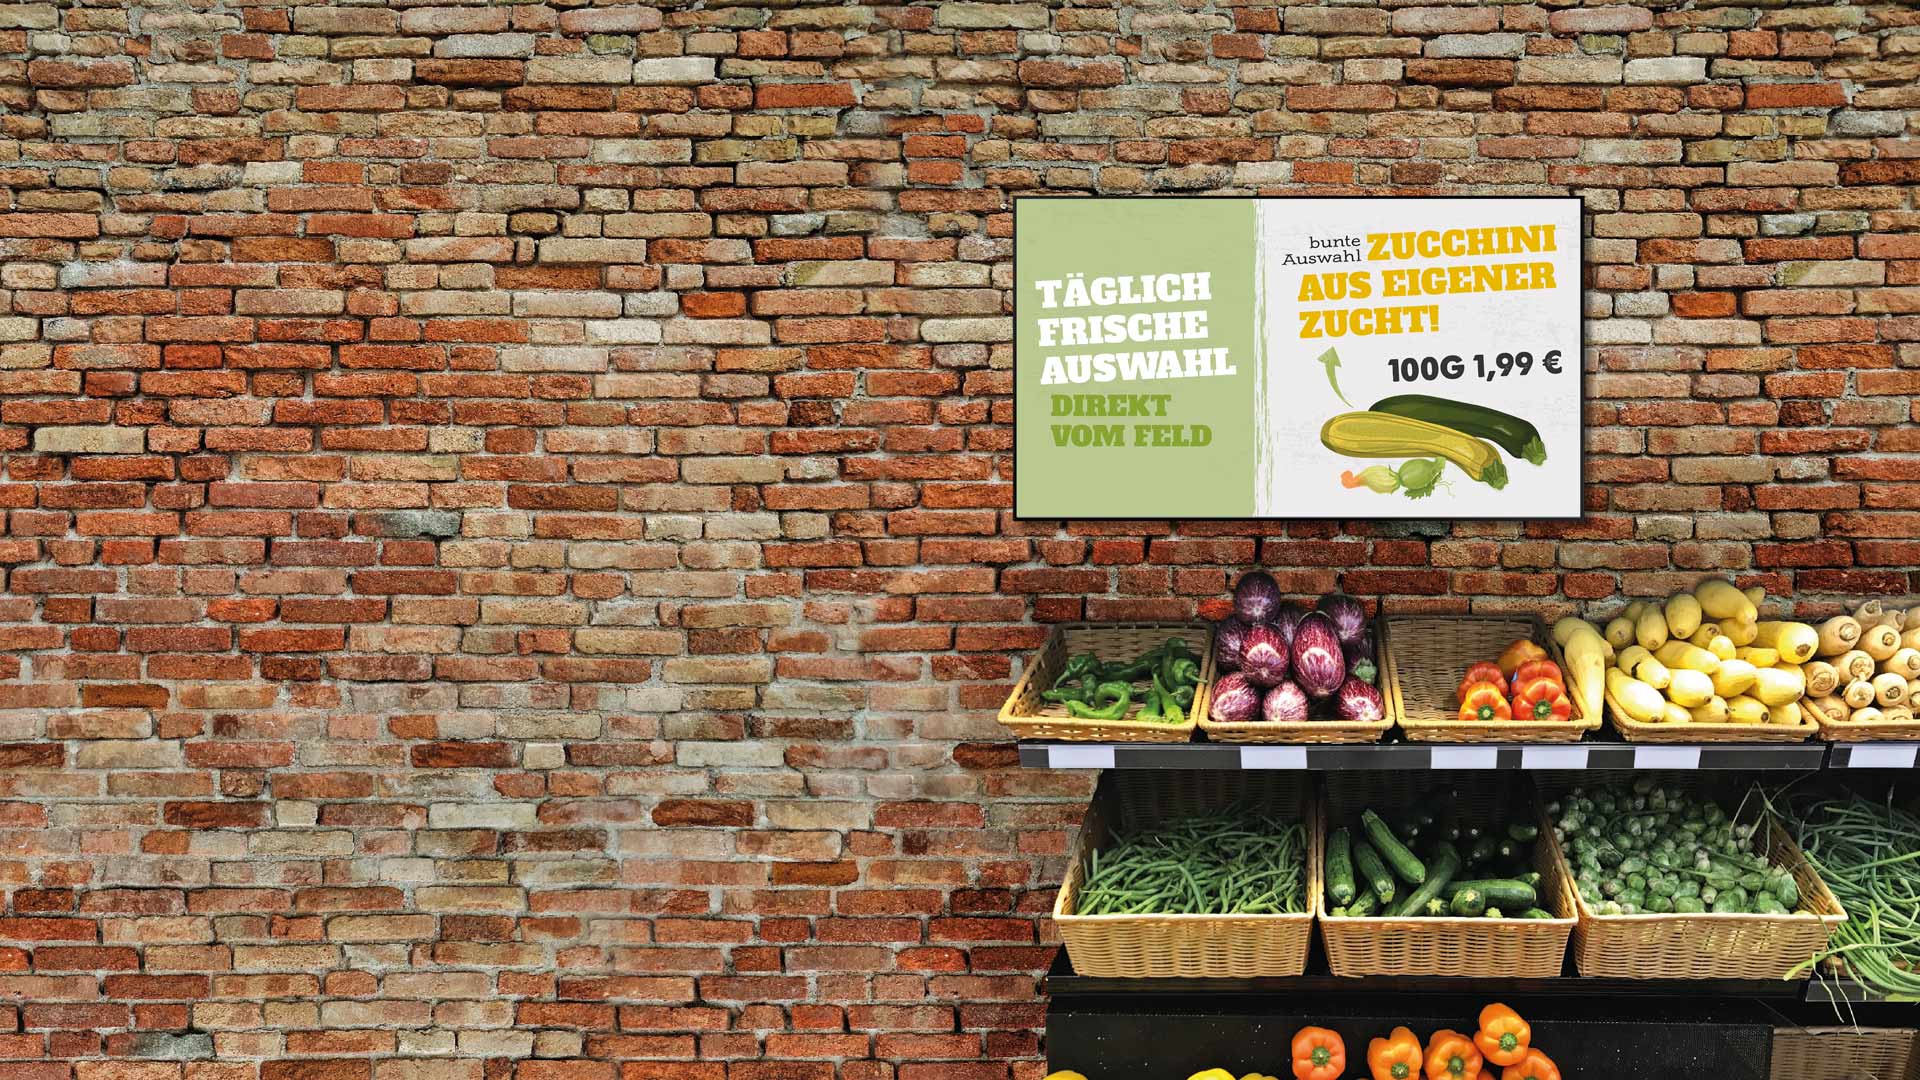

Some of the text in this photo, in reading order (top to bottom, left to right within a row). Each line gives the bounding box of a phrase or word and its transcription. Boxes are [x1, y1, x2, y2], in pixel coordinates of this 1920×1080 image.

[1281, 249, 1362, 266] Auswahl
[1309, 235, 1361, 250] bunte
[1366, 224, 1557, 261] ZUCCHINI
[1035, 272, 1212, 308] TÄGLICH
[1298, 262, 1557, 302] AUS EIGENER
[1037, 310, 1209, 347] FRISCHE
[1299, 304, 1440, 339] ZUCHT!
[1040, 347, 1237, 385] AUSWAHL
[1388, 349, 1563, 382] 100G 1,99 €
[1050, 394, 1172, 417] DIREKT
[1050, 424, 1213, 447] VOM FELD
